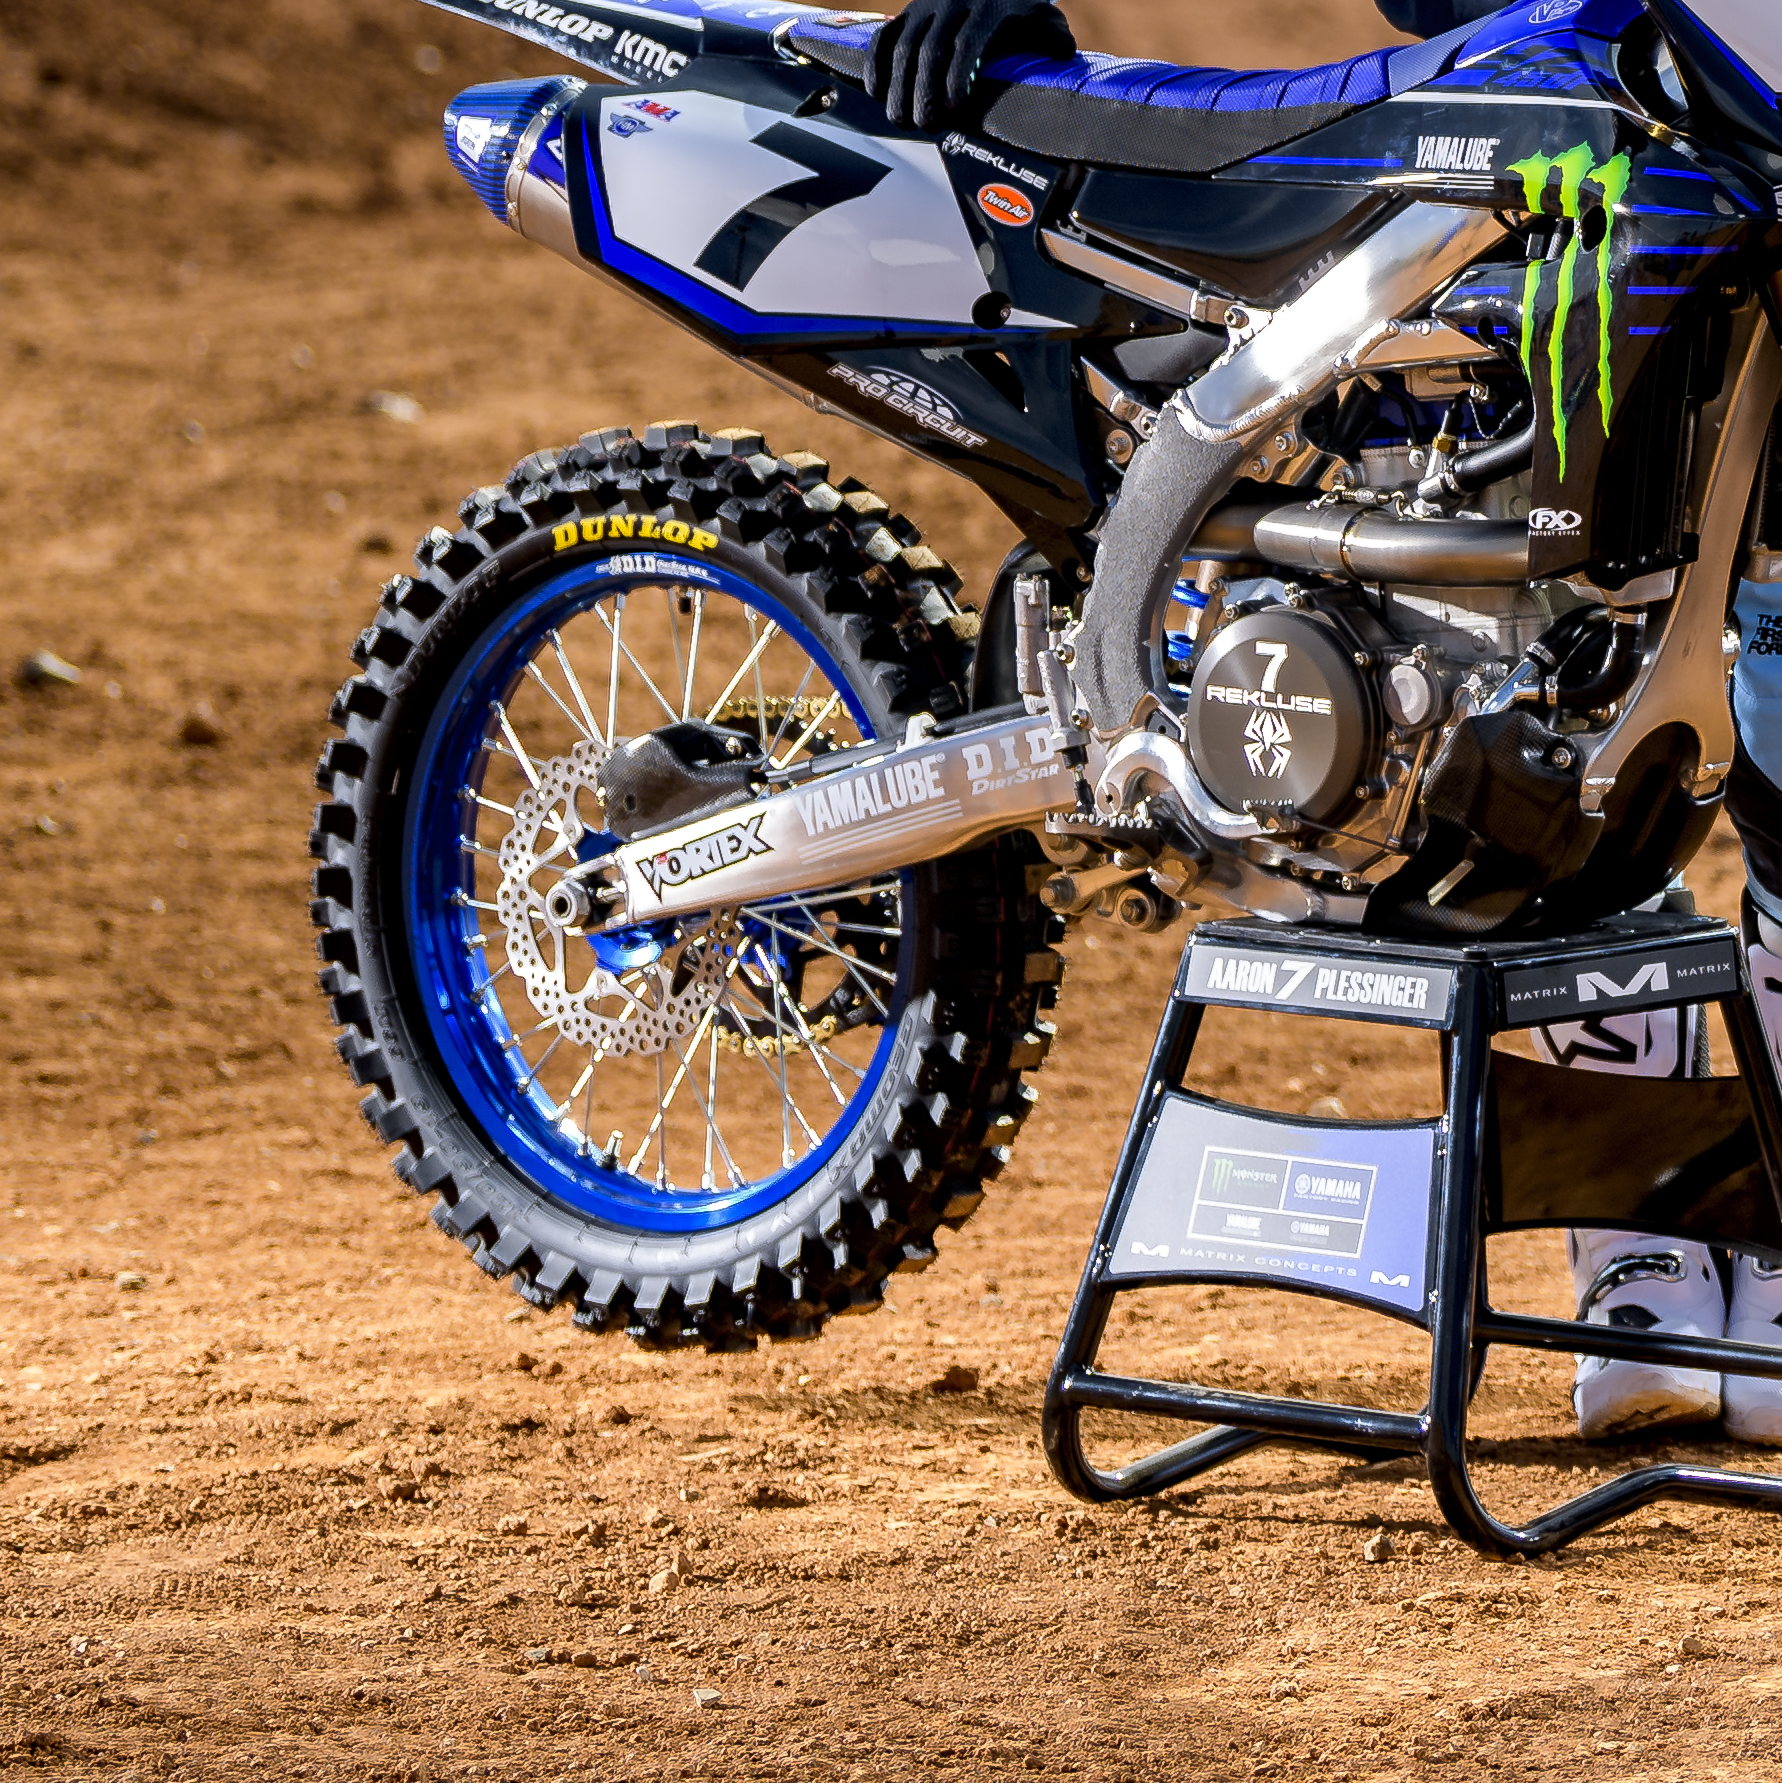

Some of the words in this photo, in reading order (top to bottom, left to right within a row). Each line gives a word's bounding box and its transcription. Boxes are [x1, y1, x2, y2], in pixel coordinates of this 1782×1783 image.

[614, 29, 691, 79] KMC
[961, 142, 1050, 191] REKLUSE
[1416, 136, 1493, 171] YAMALUBE
[693, 121, 894, 293] 7
[983, 189, 1012, 213] Twin
[1009, 204, 1030, 219] Air
[827, 362, 891, 400] PRO
[884, 391, 988, 448] CIRCUIT
[552, 514, 718, 552] DUNLOP
[1529, 507, 1582, 531] FX
[1255, 640, 1289, 693] 7
[1206, 684, 1333, 715] REKLUSE
[796, 759, 945, 838] YAMALUBE
[637, 813, 774, 902] VORTEX
[1206, 957, 1274, 996] AARON
[1274, 960, 1318, 1001] 7
[1314, 968, 1428, 1010] PLESSINGER
[1510, 987, 1568, 1002] MATRIX
[1677, 962, 1731, 979] MATRIX
[1310, 1175, 1362, 1200] YAMAHA
[1179, 1247, 1246, 1264] MATRIX
[1254, 1256, 1358, 1277] CONCEPTS
